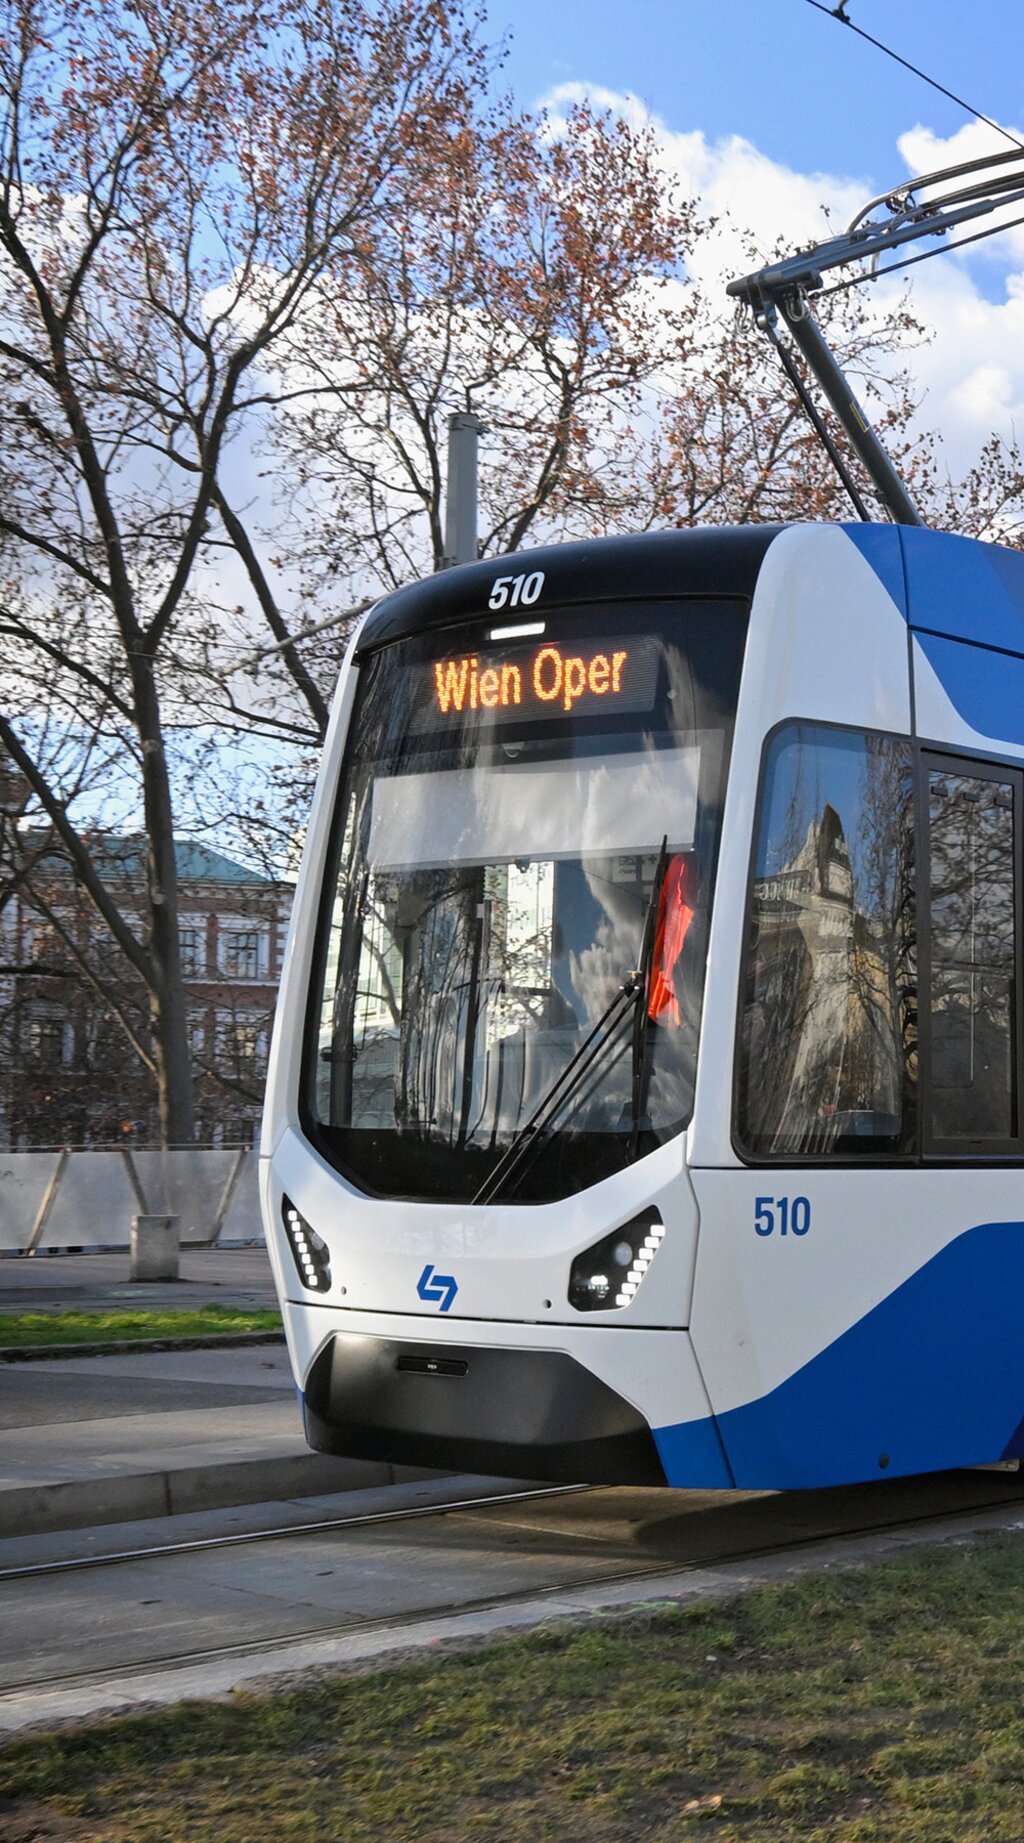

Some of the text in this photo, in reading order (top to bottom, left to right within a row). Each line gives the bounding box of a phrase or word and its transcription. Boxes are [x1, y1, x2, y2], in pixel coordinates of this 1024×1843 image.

[488, 571, 545, 610] 510
[434, 648, 628, 713] Wien Oper
[754, 1196, 811, 1237] 510
